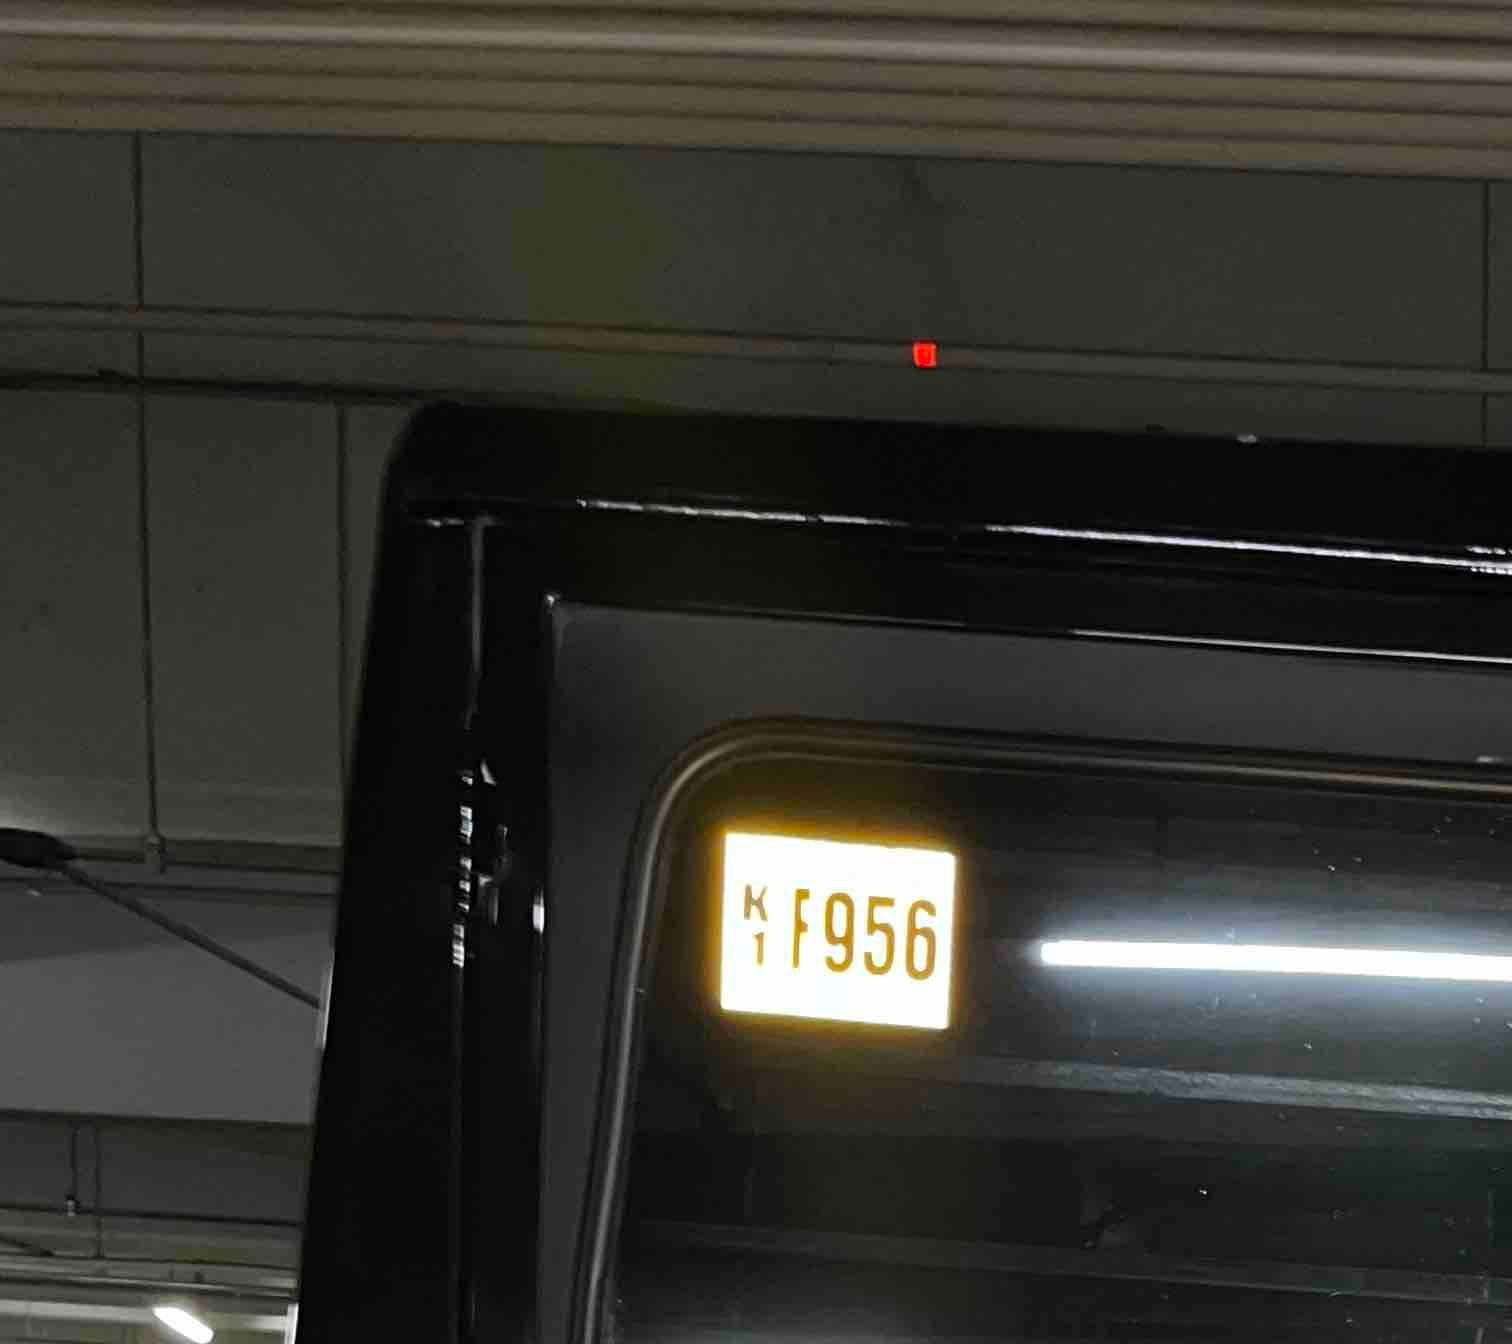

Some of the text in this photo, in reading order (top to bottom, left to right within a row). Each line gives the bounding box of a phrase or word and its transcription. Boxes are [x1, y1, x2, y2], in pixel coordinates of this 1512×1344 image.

[743, 884, 768, 921] K
[754, 932, 765, 966] 1
[793, 888, 936, 980] F956
